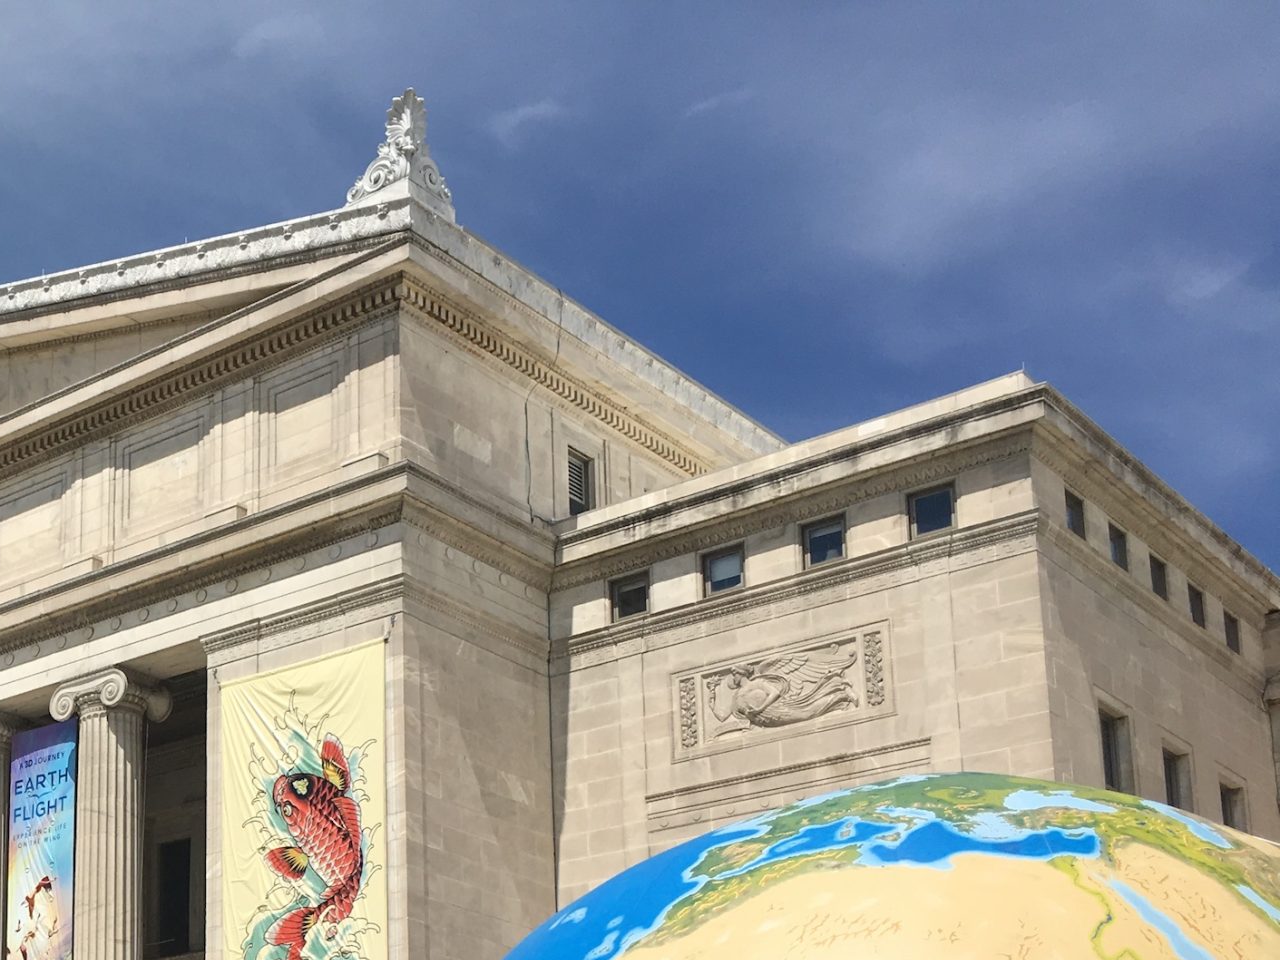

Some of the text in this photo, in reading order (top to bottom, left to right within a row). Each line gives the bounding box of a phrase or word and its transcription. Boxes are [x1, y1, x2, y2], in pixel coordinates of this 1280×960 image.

[34, 752, 65, 765] JOURNEY
[14, 767, 68, 795] EARTH
[13, 796, 67, 823] FLIGHT
